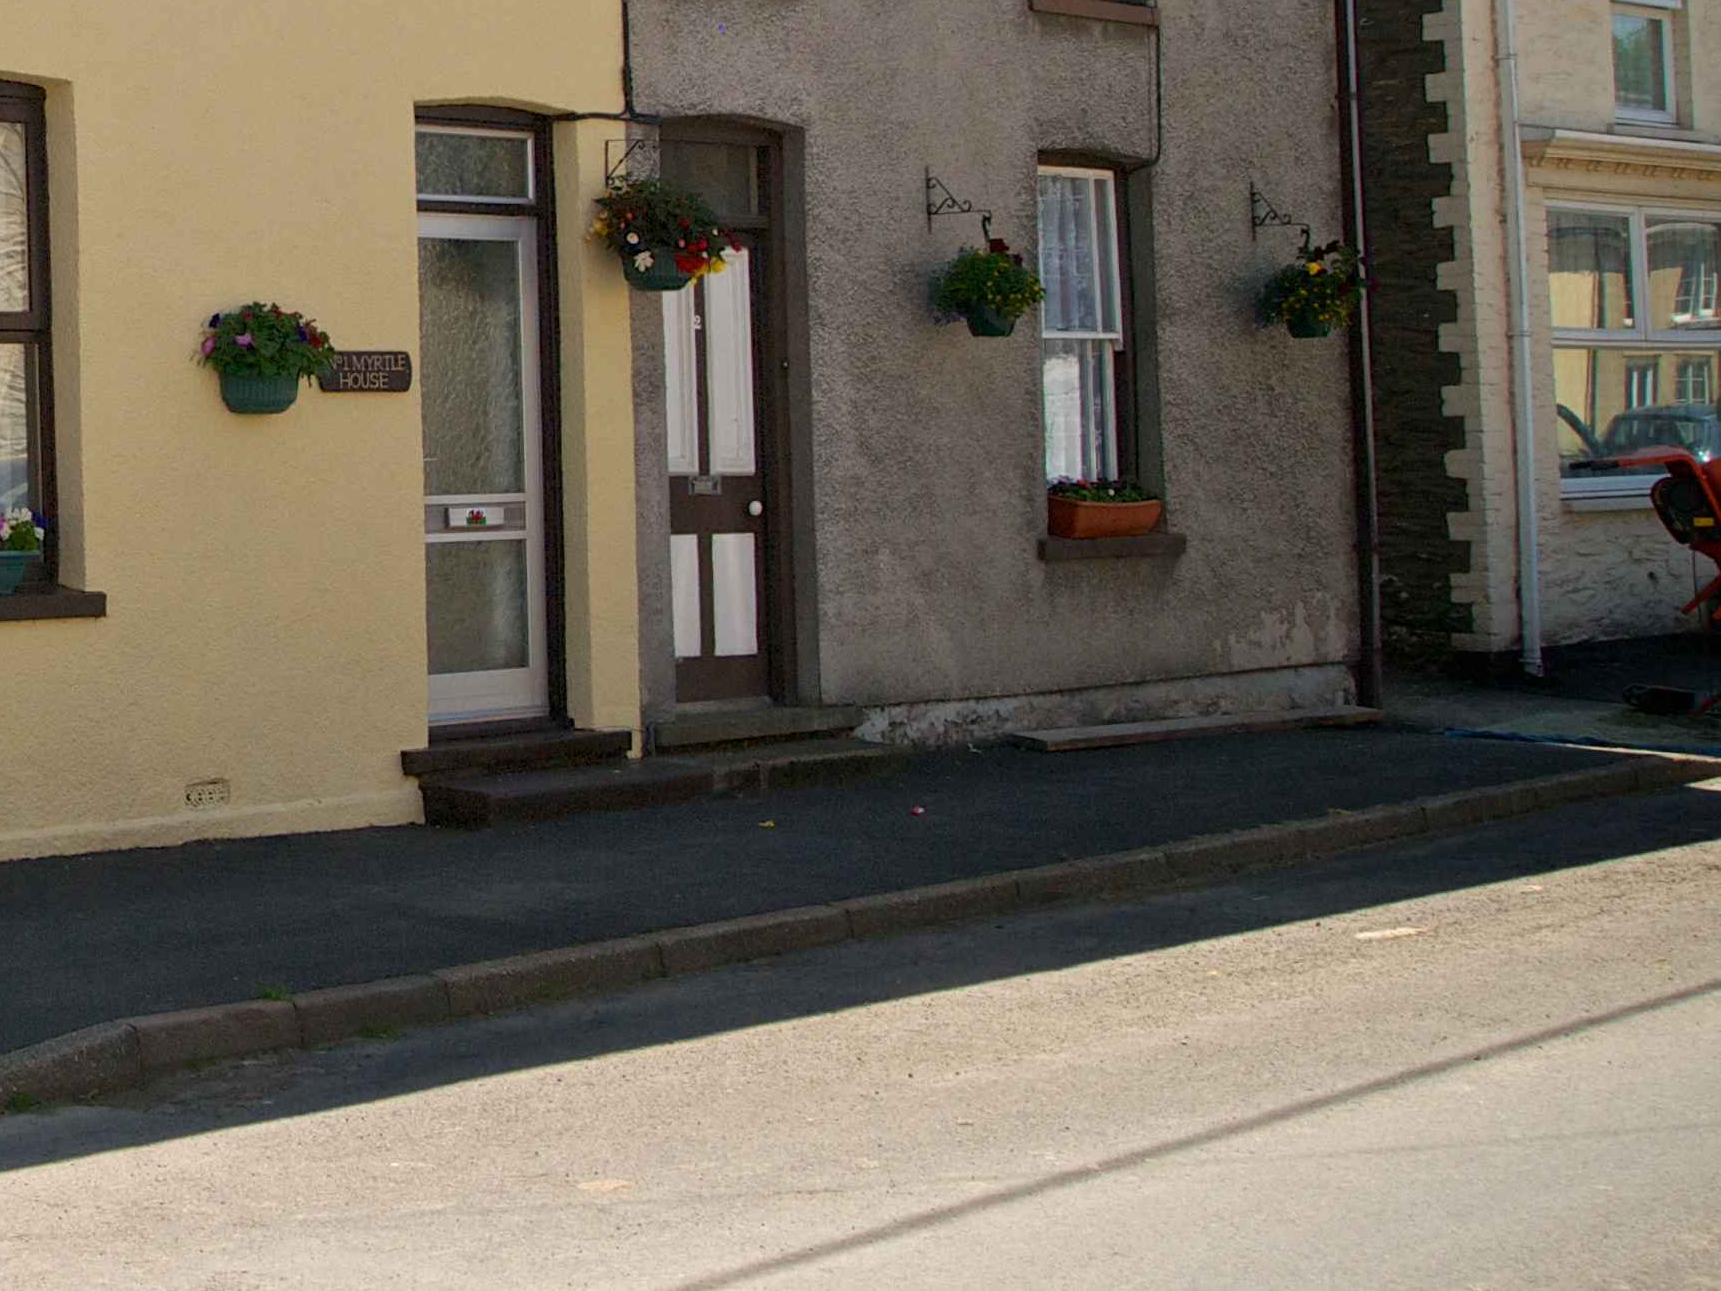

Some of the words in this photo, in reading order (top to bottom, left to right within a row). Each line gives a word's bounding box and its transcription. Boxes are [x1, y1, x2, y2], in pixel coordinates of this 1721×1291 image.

[694, 315, 701, 329] 2
[352, 354, 406, 371] MYRTLE
[339, 372, 389, 389] HOUSE
